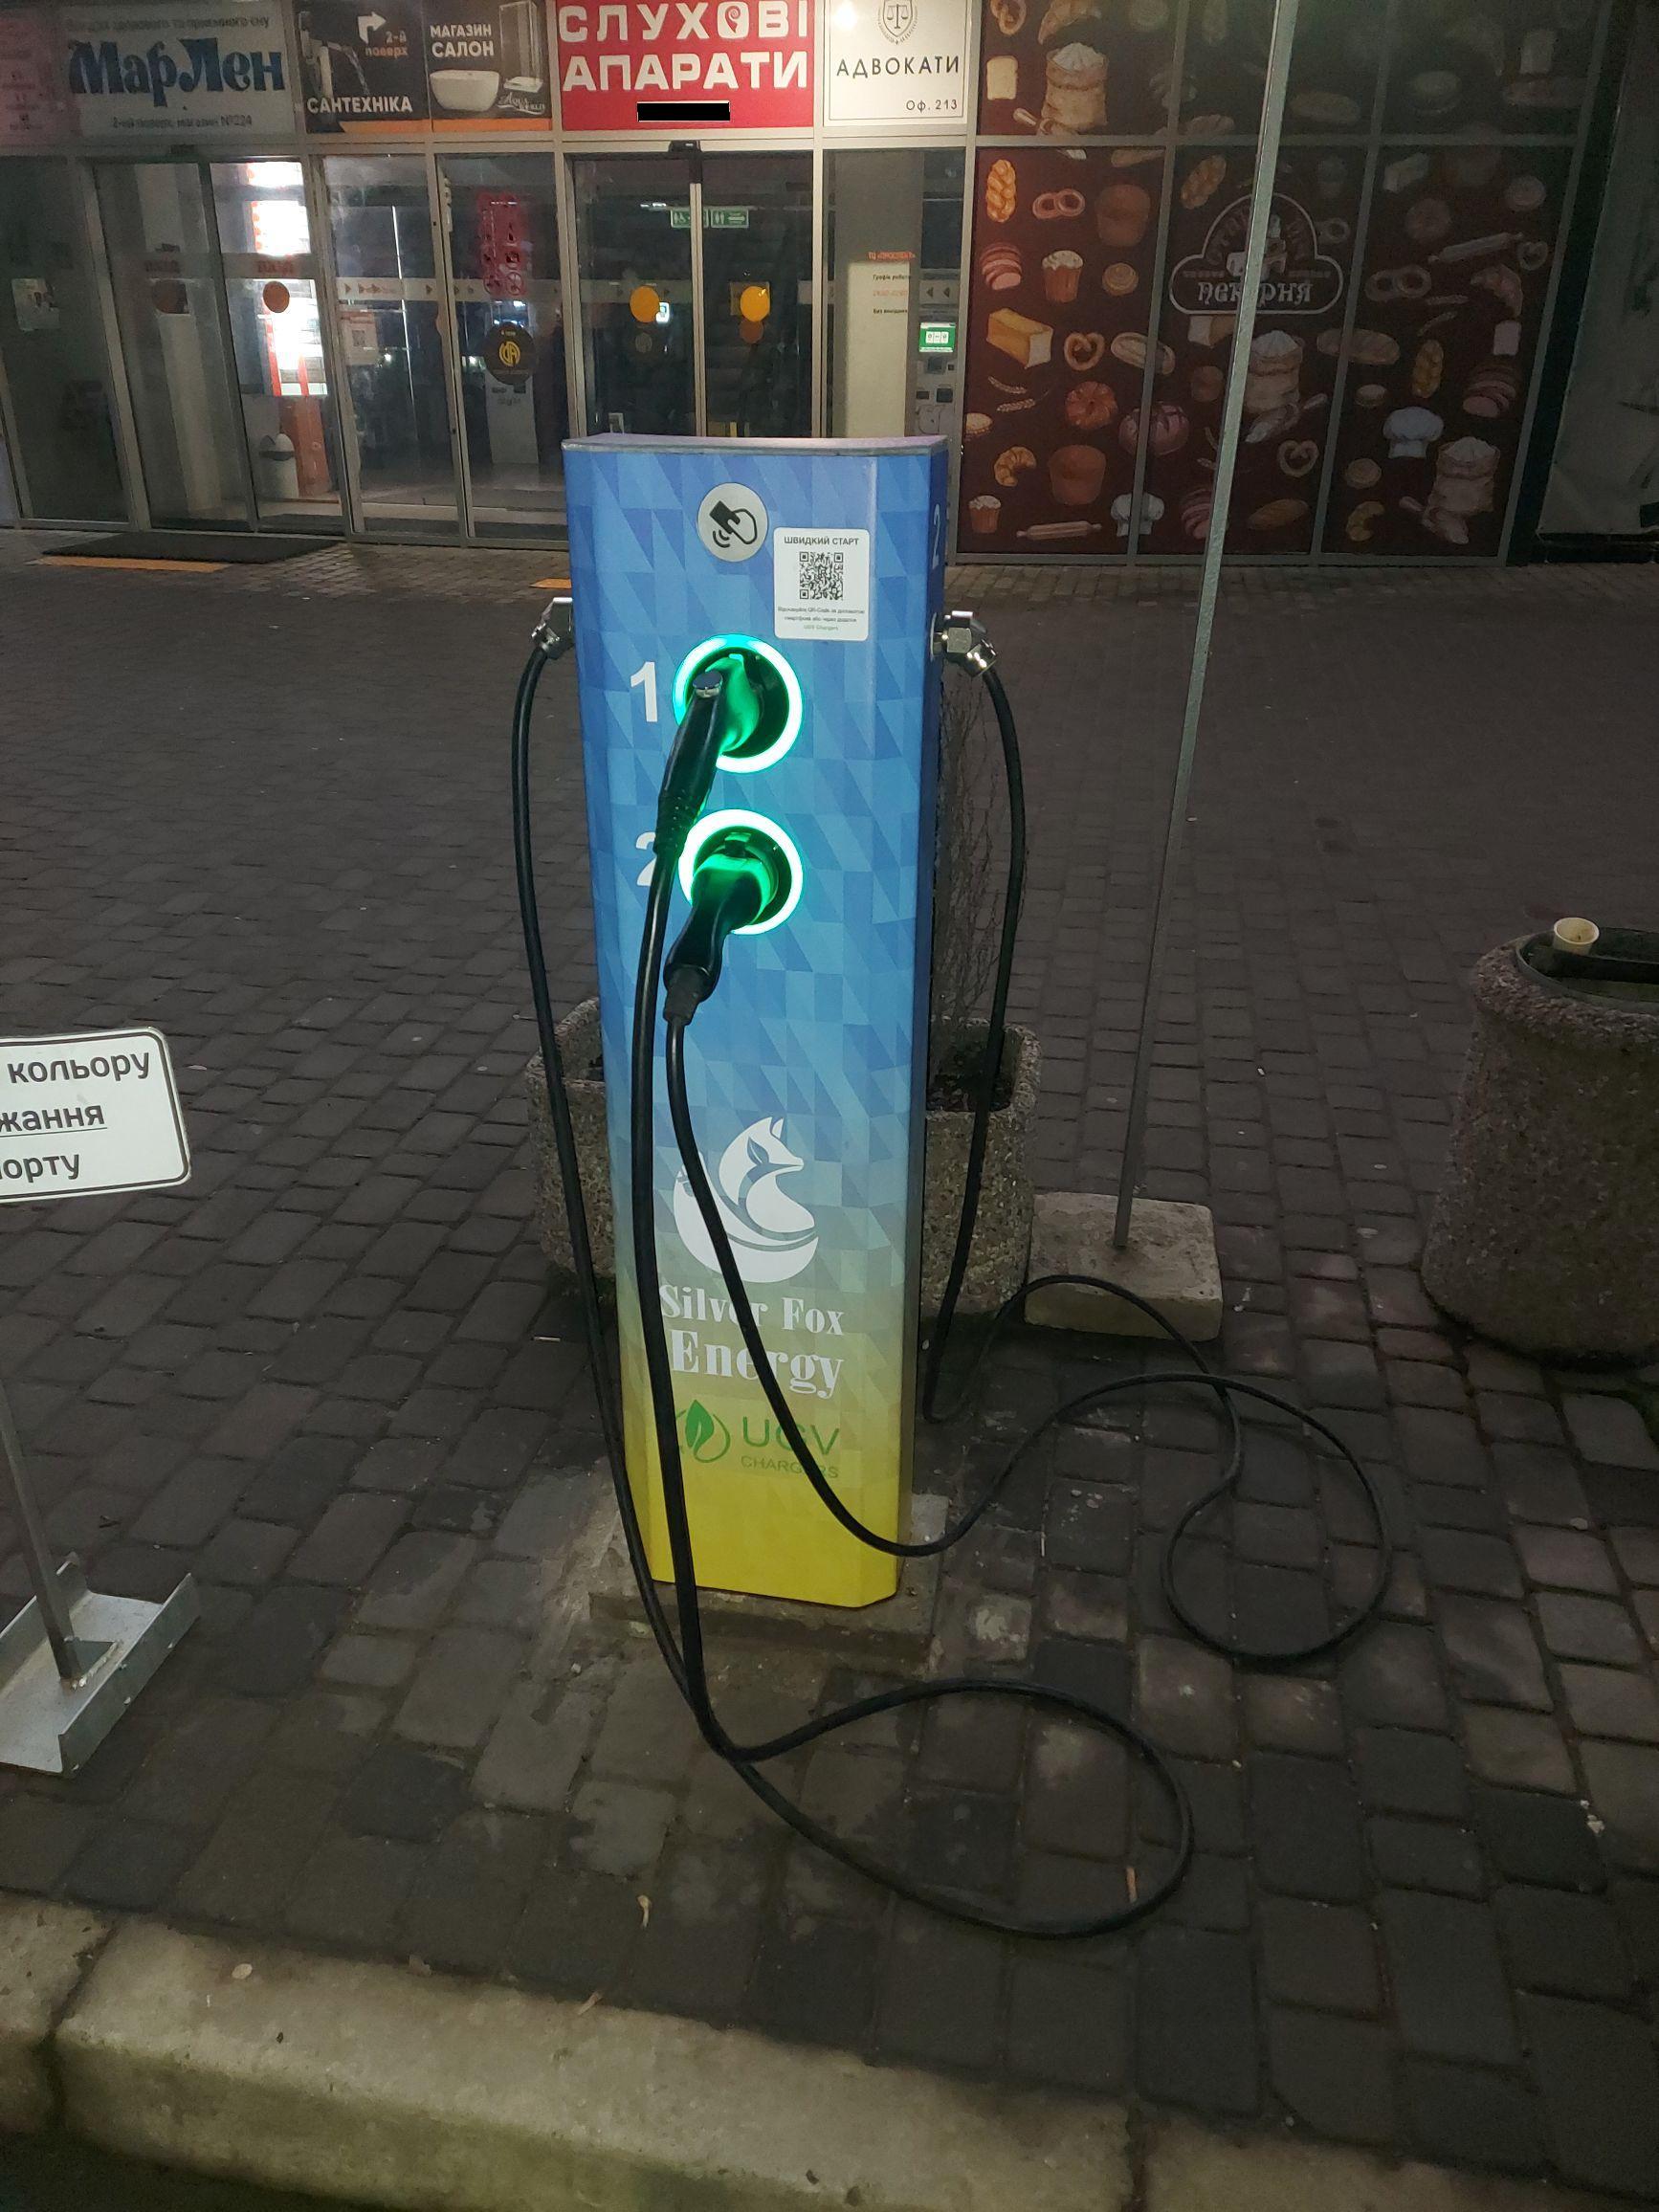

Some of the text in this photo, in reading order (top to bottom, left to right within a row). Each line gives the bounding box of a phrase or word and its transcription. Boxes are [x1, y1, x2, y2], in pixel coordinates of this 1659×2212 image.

[430, 24, 492, 38] МАГАЗИН
[559, 0, 808, 43] СЛУХОВІ
[431, 40, 495, 58] САЛОН
[68, 37, 286, 108] МарЛен
[562, 51, 807, 92] АПАРАТИ
[836, 55, 960, 79] АДВОКАТИ
[307, 97, 413, 114] САНТЕХНІКА
[906, 99, 959, 114] Оф. 213
[784, 535, 859, 545] ШВИДКИЙ СТАРТ
[630, 661, 658, 722] 1
[7, 1051, 150, 1084] кольору
[0, 1154, 80, 1183] орту
[781, 1296, 845, 1337] Fox
[670, 1329, 845, 1400] Energy
